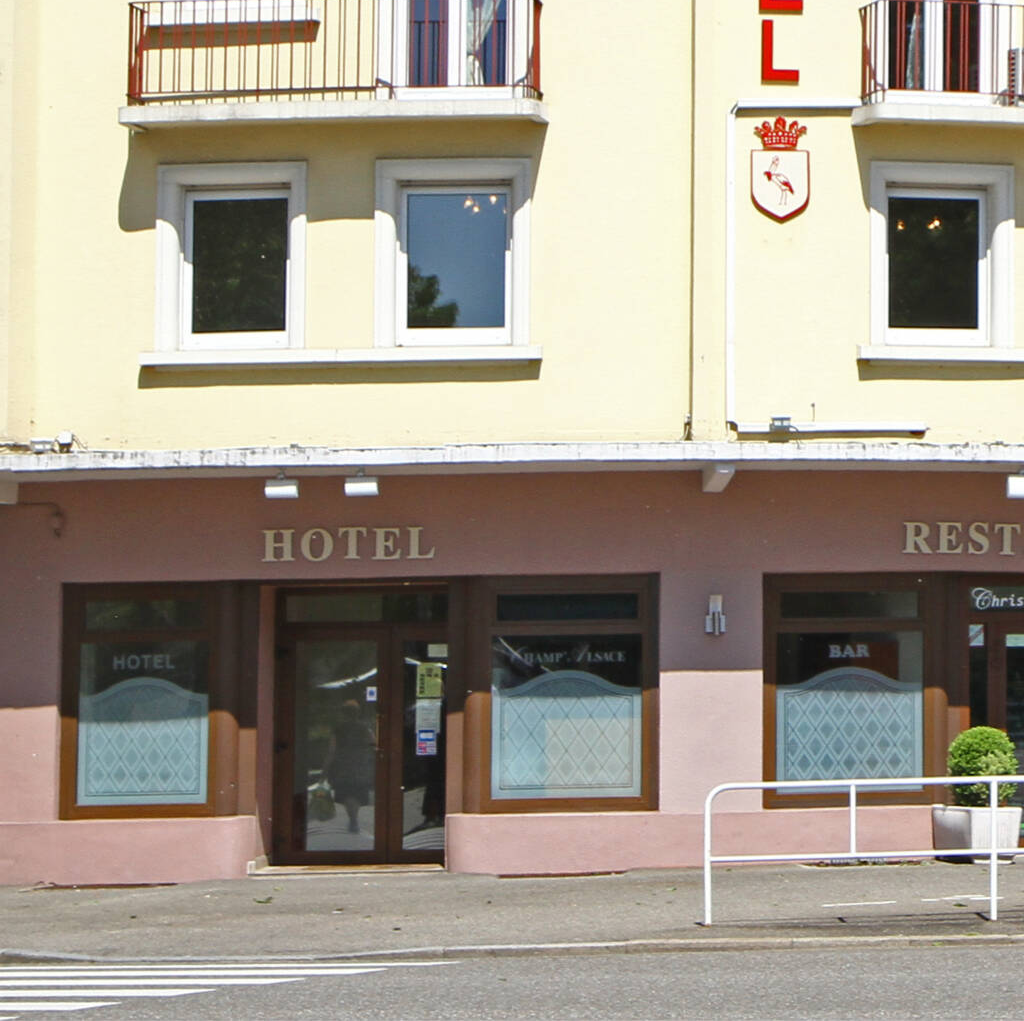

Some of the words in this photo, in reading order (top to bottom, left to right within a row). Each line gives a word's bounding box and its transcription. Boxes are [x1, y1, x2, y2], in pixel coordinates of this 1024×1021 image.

[261, 526, 436, 563] HOTEL
[828, 644, 870, 658] BAR
[112, 654, 176, 670] HOTEL
